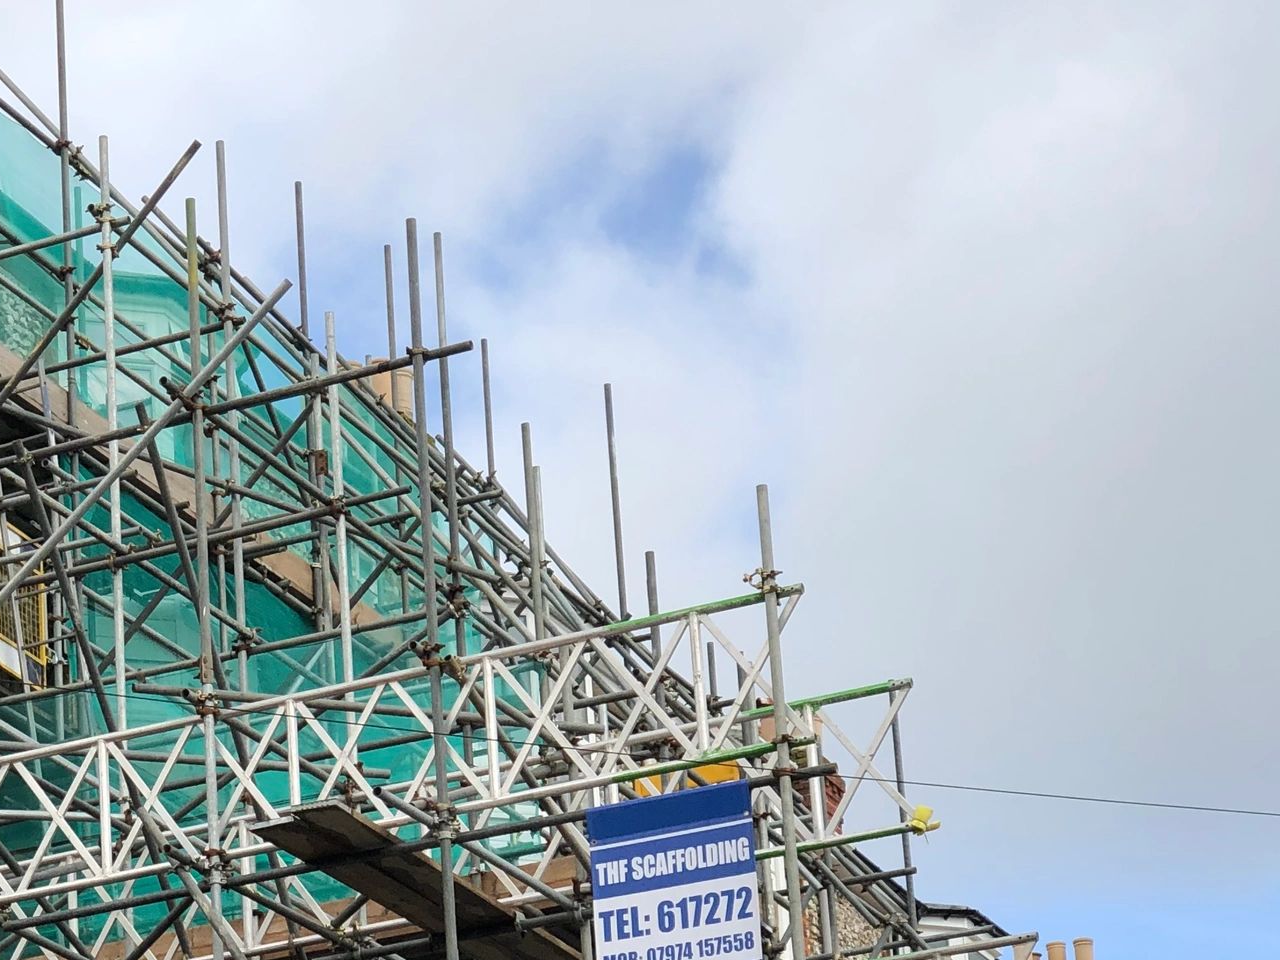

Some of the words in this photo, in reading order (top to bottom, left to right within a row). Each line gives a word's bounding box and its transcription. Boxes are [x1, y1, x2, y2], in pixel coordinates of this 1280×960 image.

[596, 859, 628, 886] THF
[632, 837, 749, 880] SCAFFOLDING
[599, 906, 651, 942] TEL:
[657, 886, 753, 932] 617272
[696, 931, 754, 958] 157558
